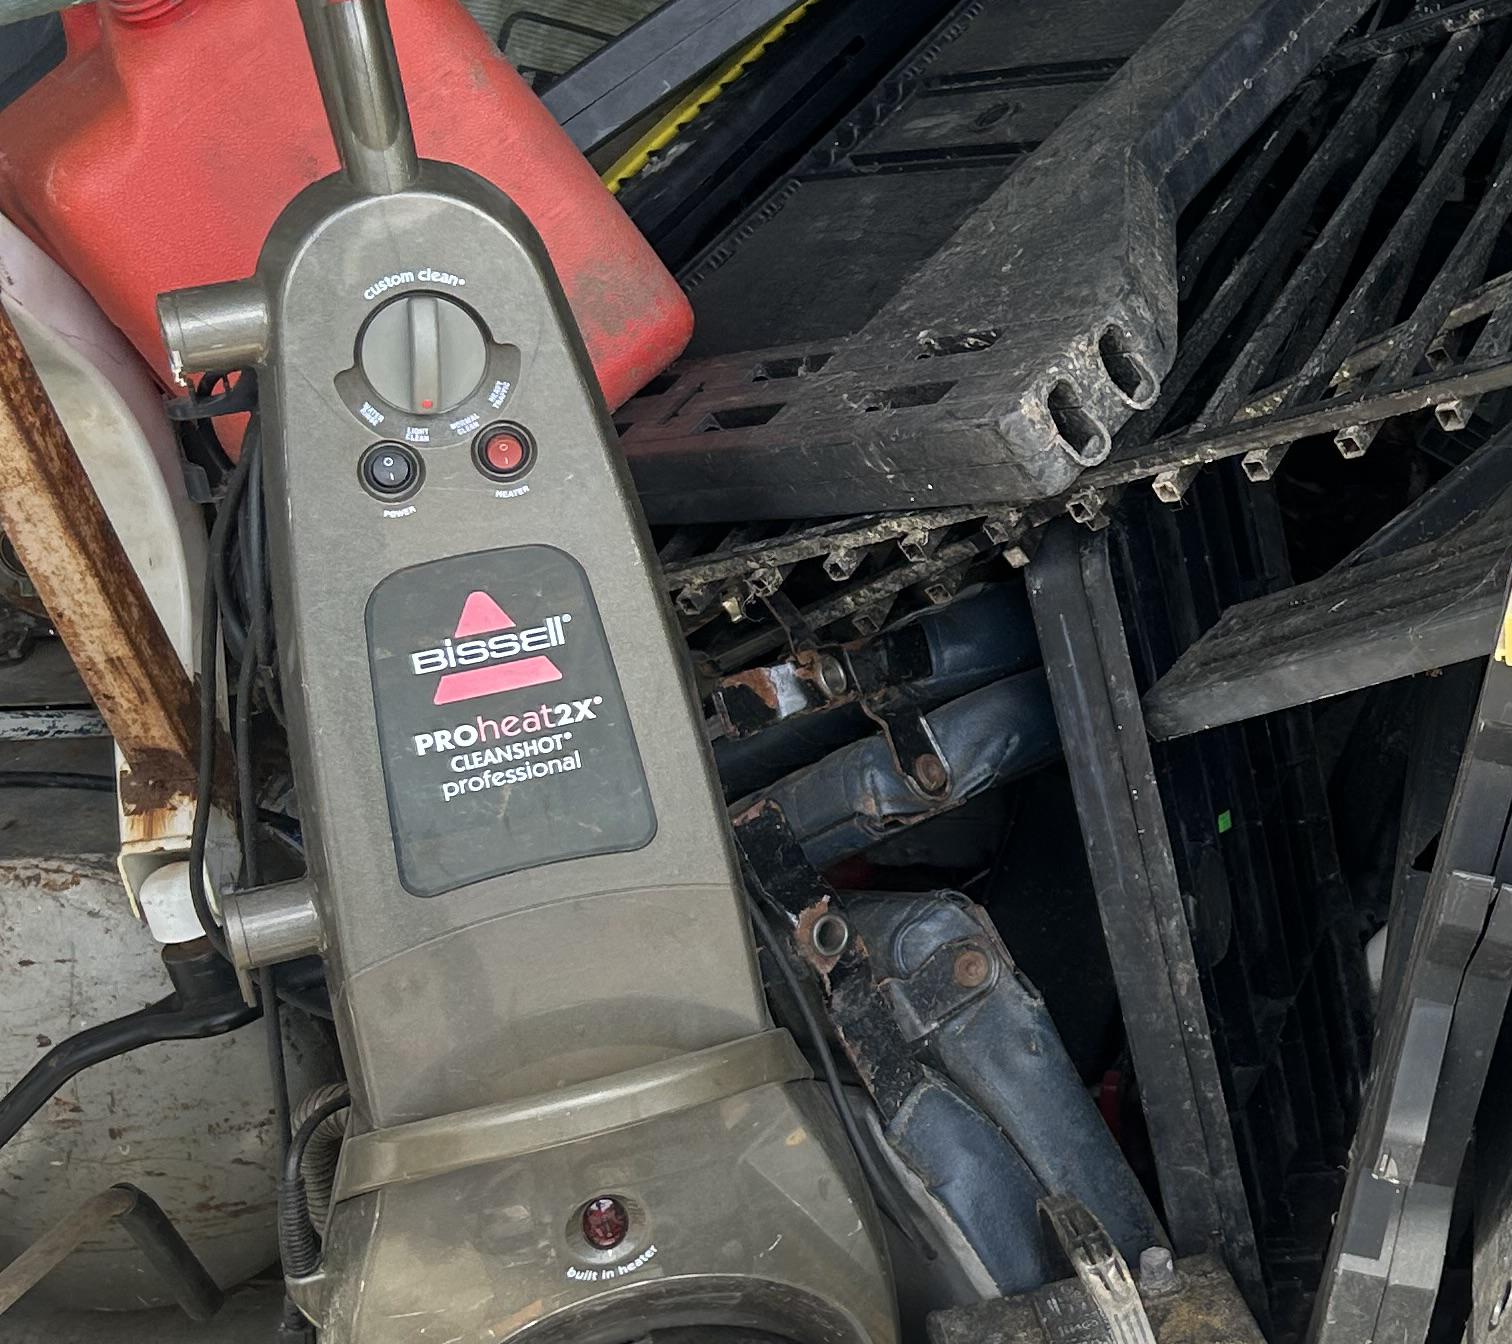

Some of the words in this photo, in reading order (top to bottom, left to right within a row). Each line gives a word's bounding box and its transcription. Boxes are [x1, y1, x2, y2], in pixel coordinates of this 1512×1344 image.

[363, 270, 415, 301] custom
[495, 485, 530, 499] HEATER
[383, 506, 417, 519] POWER
[450, 734, 564, 773] CLEANSHOT
[441, 750, 582, 802] professional
[566, 1266, 598, 1281] built
[601, 1269, 615, 1280] in
[617, 1244, 658, 1276] heater
